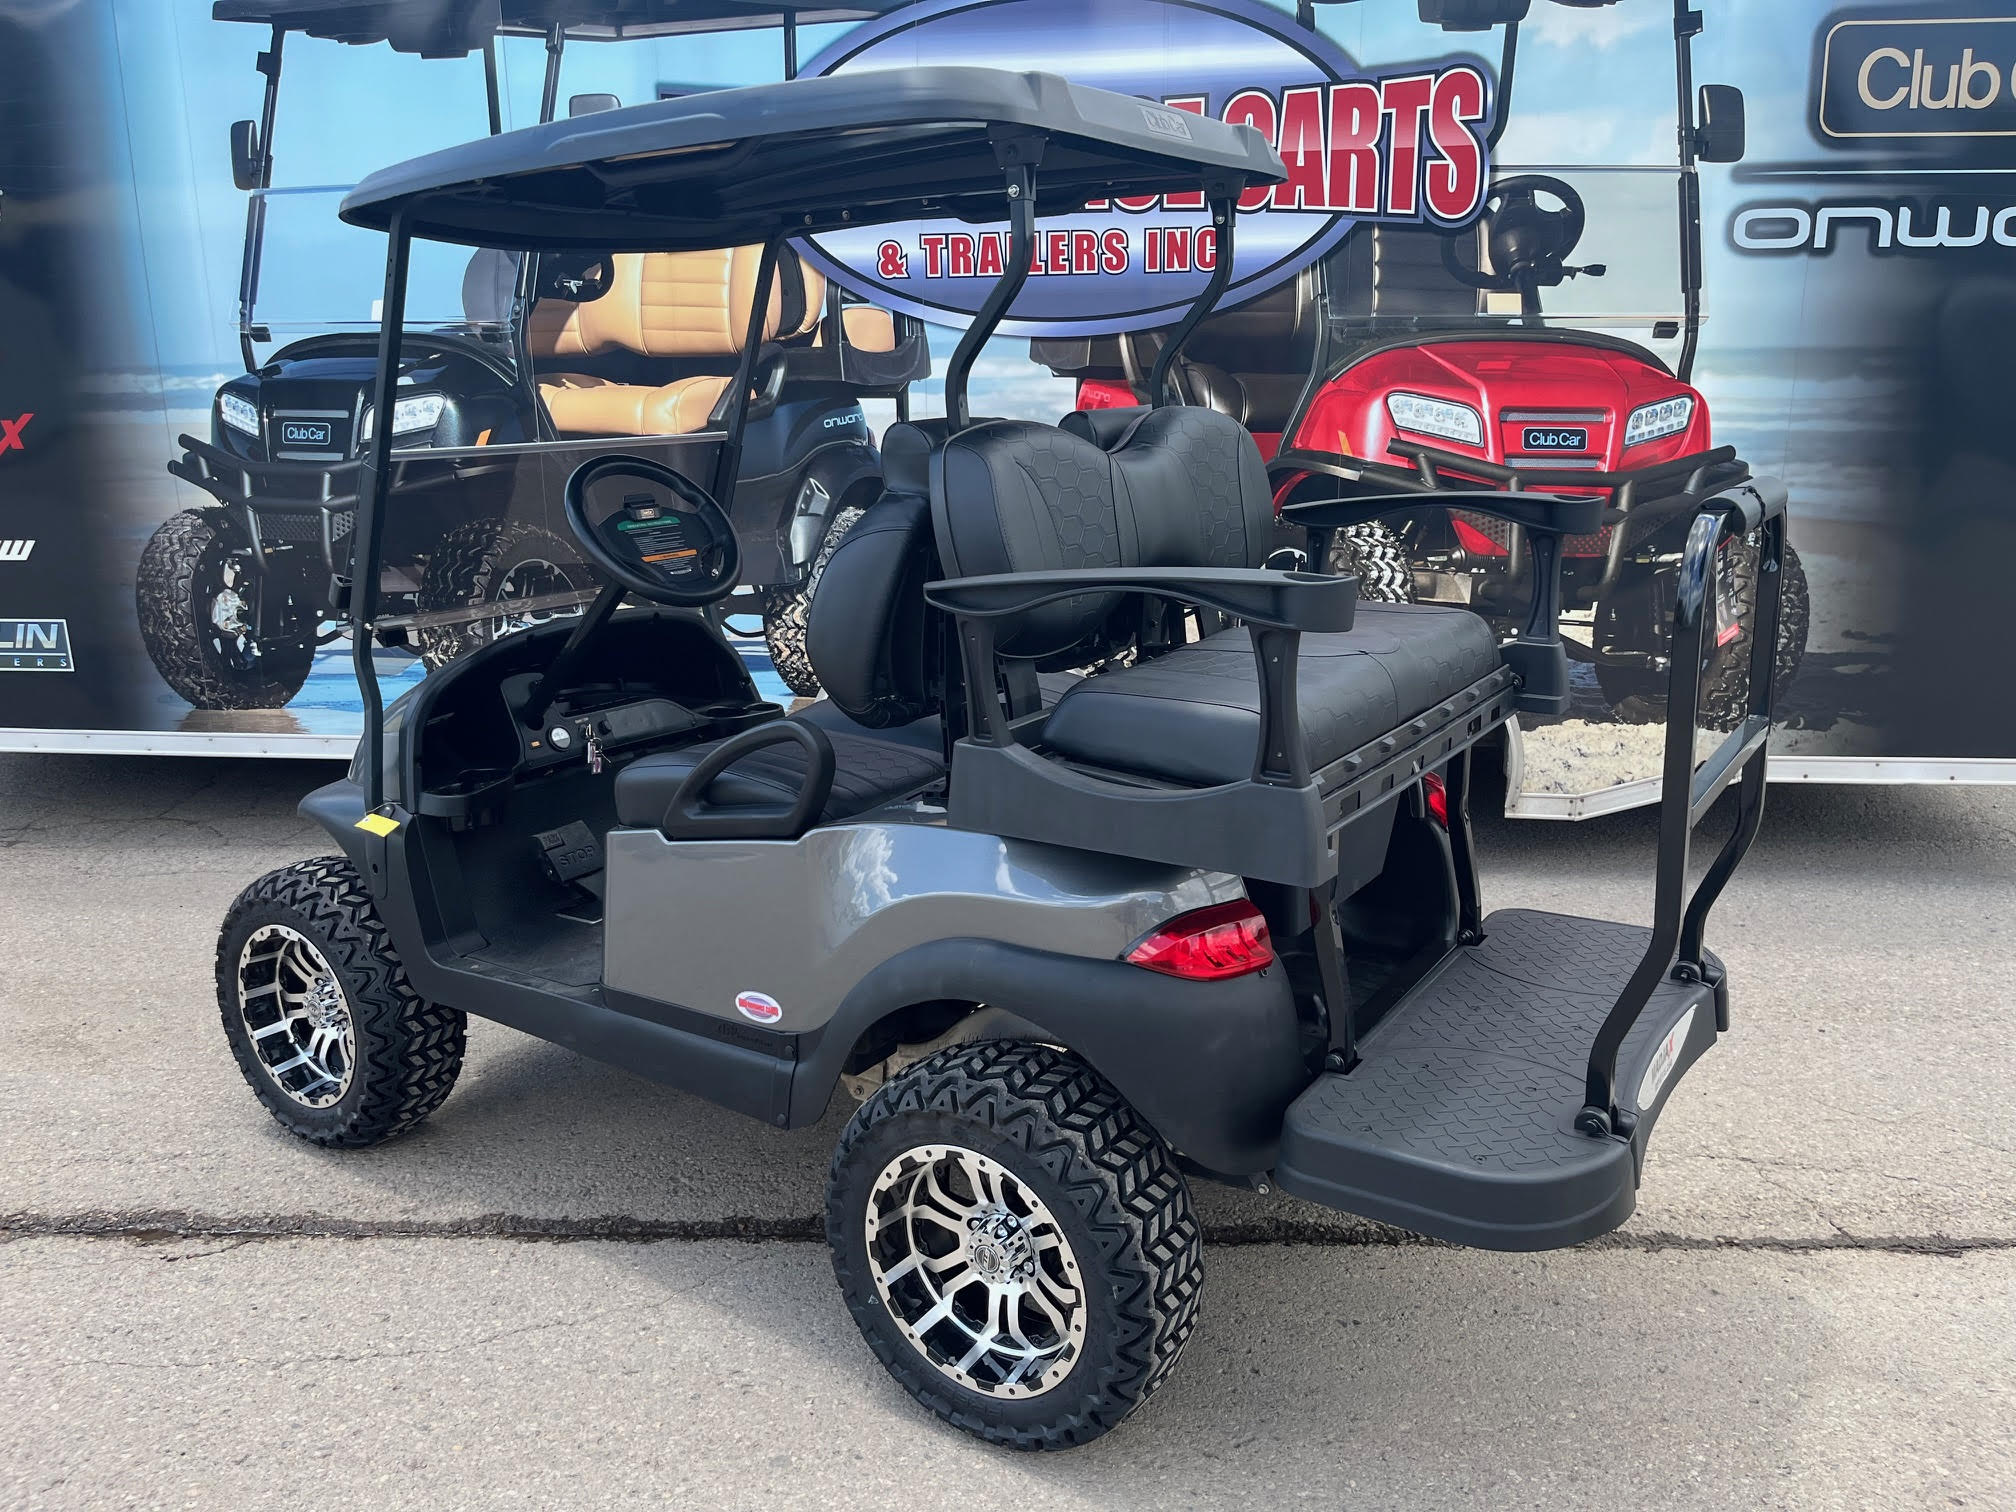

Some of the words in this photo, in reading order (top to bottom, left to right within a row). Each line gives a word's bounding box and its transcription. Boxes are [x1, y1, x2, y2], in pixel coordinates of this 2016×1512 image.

[1857, 47, 2001, 110] Club
[876, 238, 911, 279] &
[920, 229, 1129, 277] TRALERS
[287, 426, 308, 440] Club
[308, 427, 326, 440] Car
[1529, 432, 1558, 446] Club
[1559, 432, 1581, 446] Car
[559, 845, 595, 867] STOP
